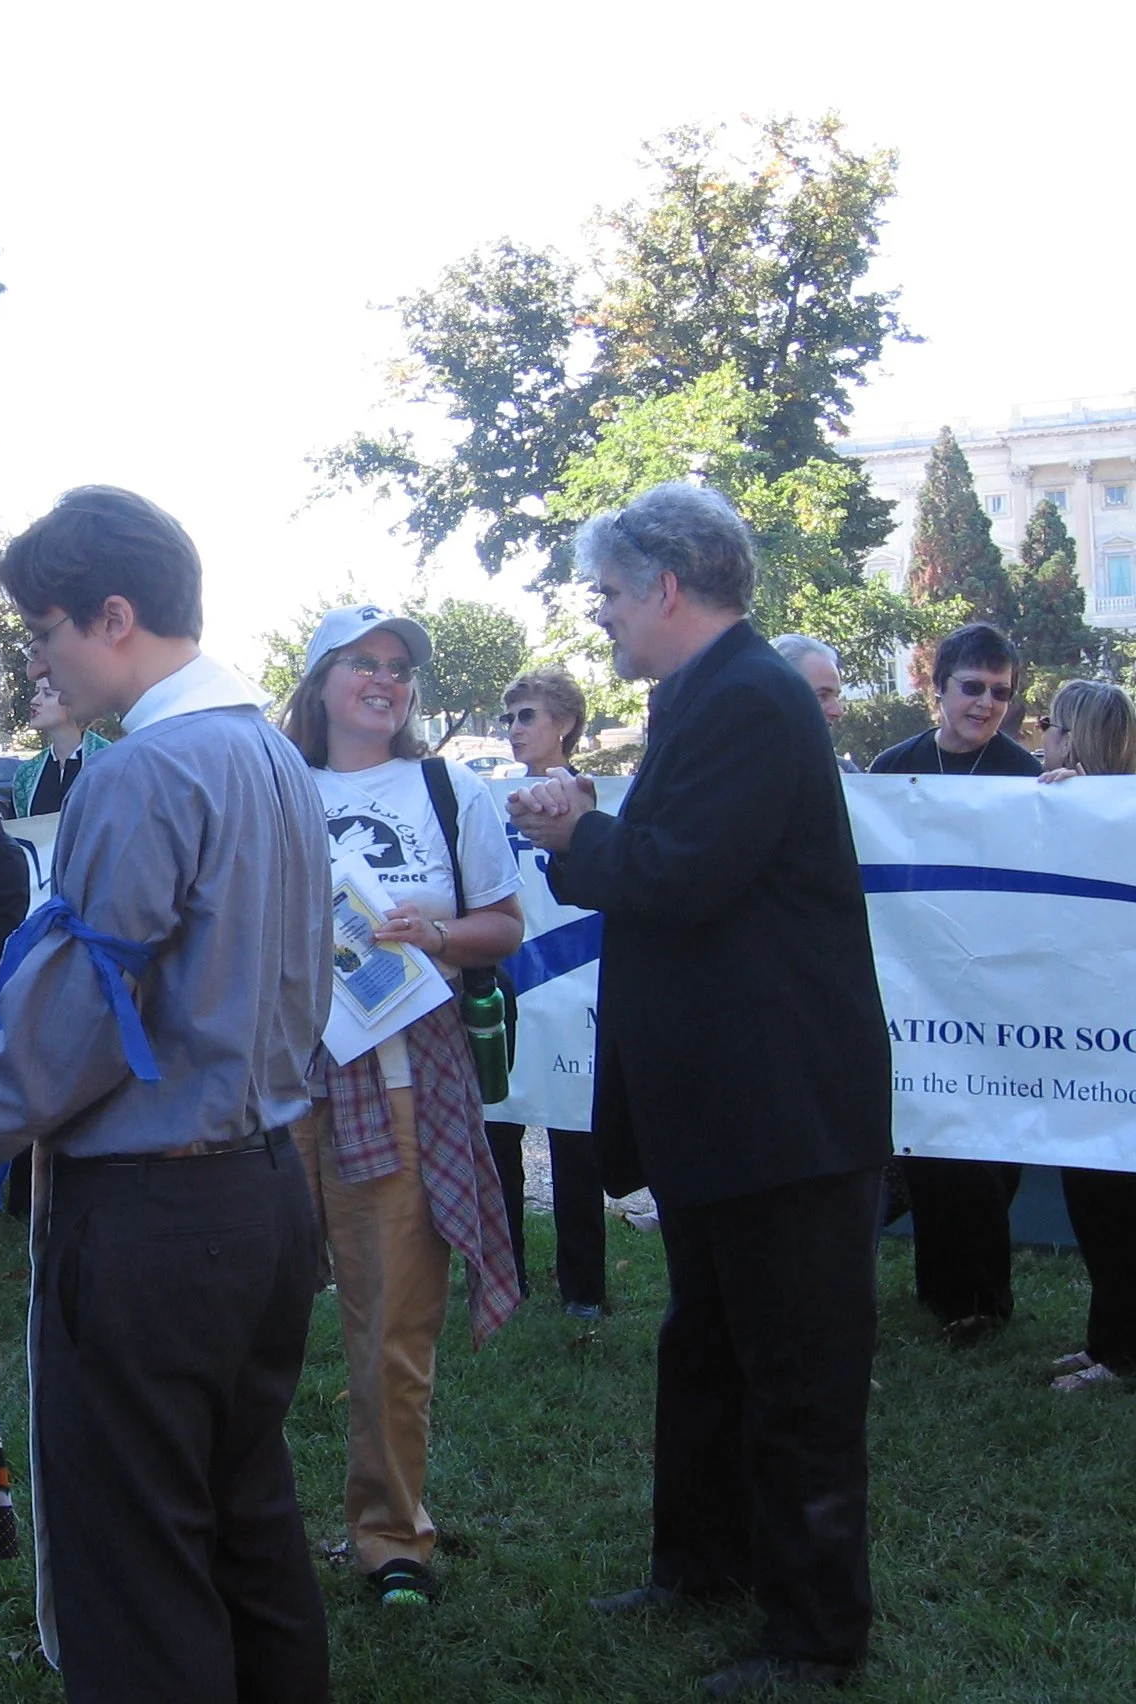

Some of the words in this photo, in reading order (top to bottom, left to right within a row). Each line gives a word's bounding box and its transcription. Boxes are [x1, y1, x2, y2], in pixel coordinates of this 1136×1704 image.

[996, 1023, 1067, 1050] FOR
[552, 1053, 581, 1074] An
[893, 1070, 914, 1092] in
[922, 1072, 958, 1095] the
[966, 1073, 1045, 1099] United
